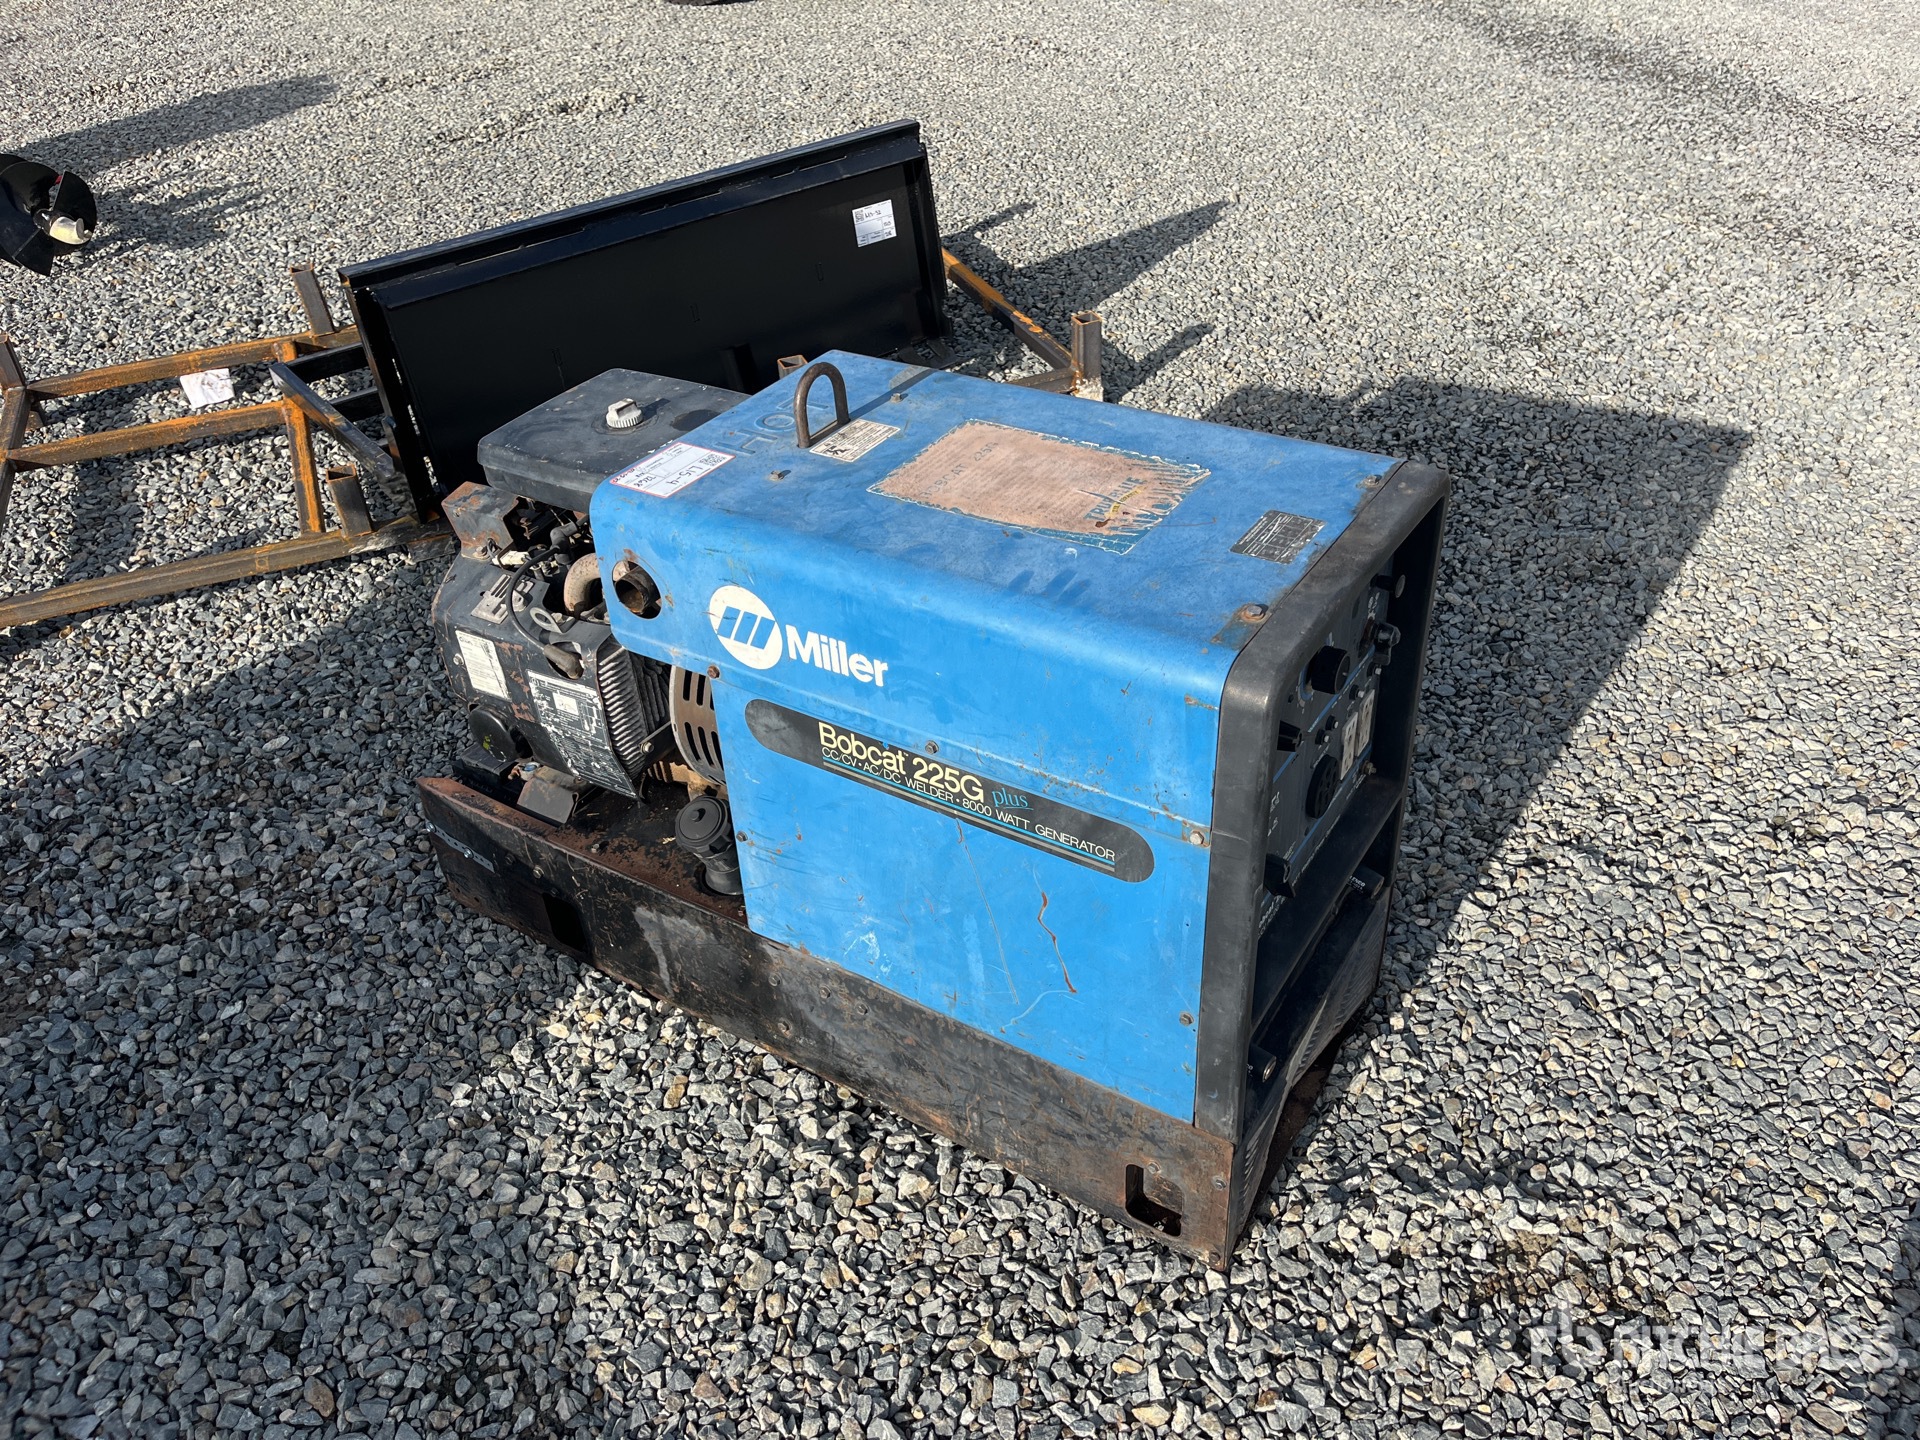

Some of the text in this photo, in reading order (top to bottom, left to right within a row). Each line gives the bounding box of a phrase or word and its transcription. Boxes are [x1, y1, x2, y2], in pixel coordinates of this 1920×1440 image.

[785, 624, 889, 687] Miller
[818, 721, 1029, 808] Bobcat 225G plus
[821, 746, 1116, 862] CC/CV AC/DC WELDER 8000 WATT GENERATOR
